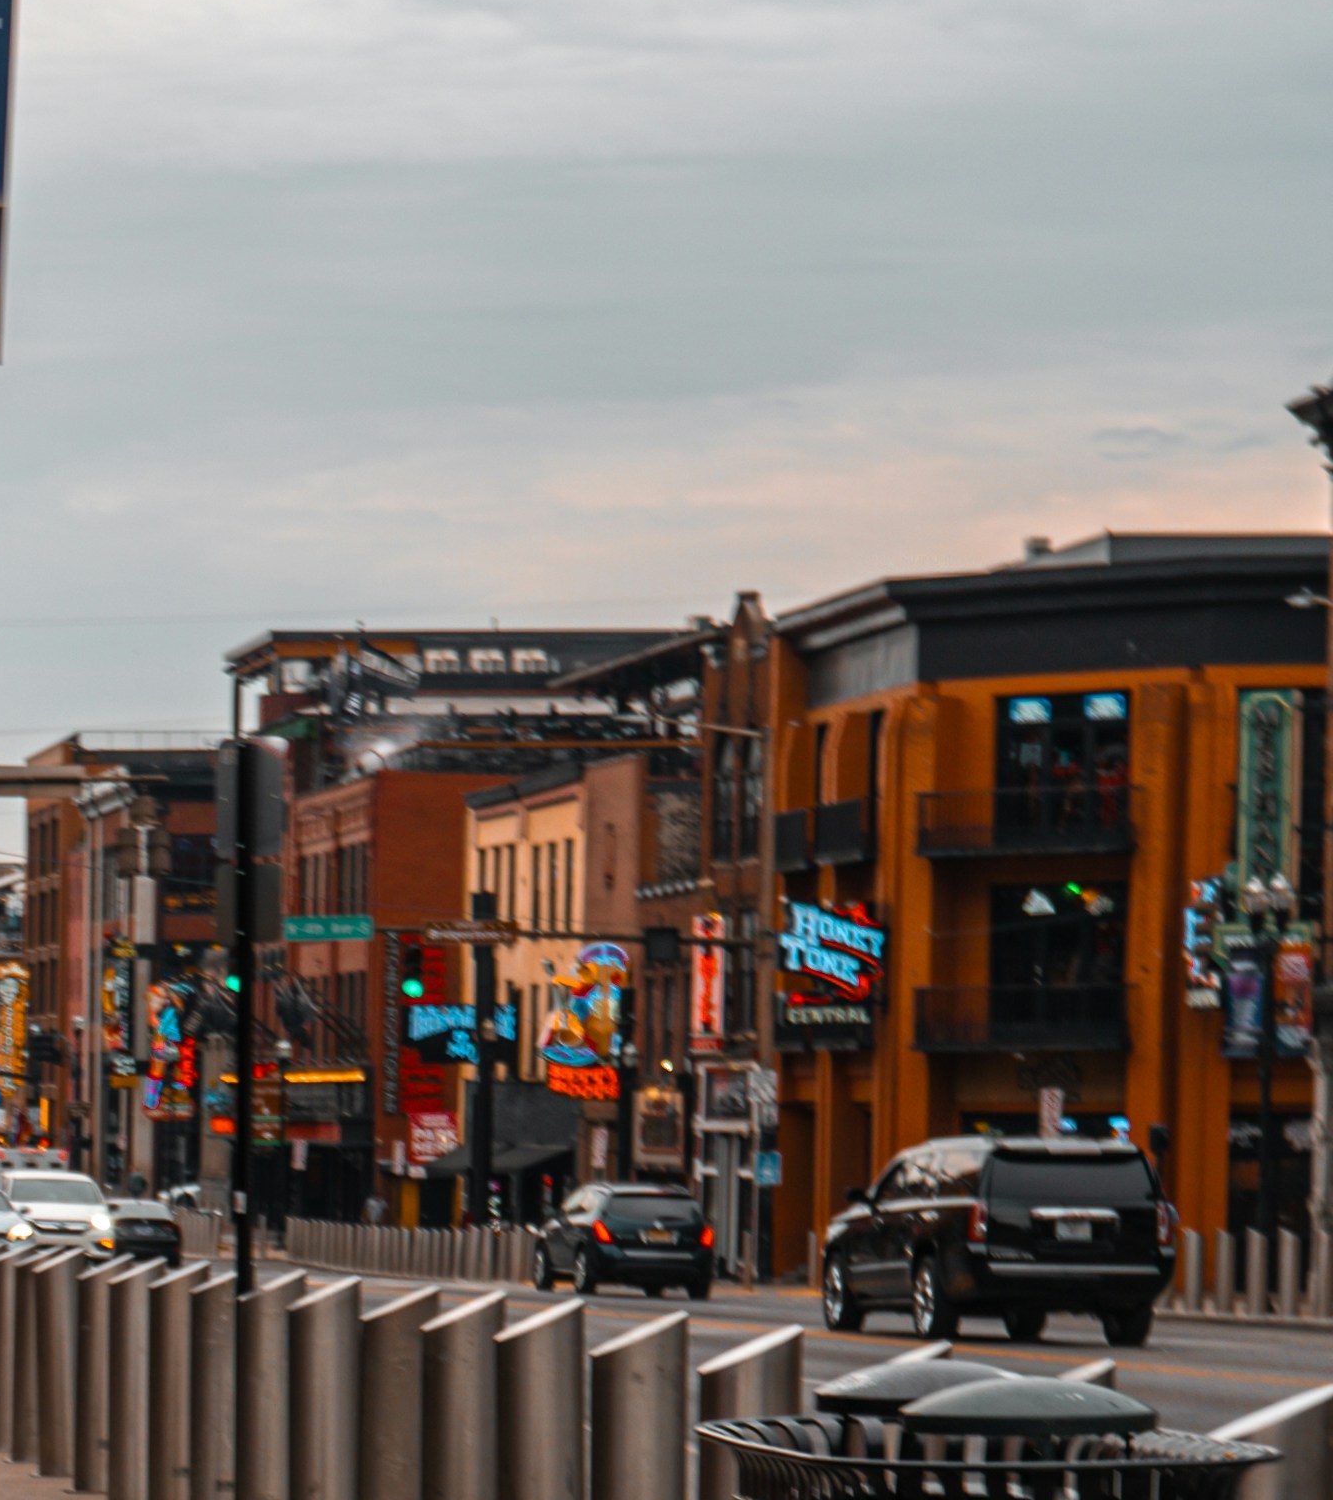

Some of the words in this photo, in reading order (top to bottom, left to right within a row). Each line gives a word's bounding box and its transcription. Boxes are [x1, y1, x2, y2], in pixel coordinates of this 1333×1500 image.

[791, 902, 885, 959] HONKY
[780, 932, 860, 987] TONK
[787, 1005, 872, 1025] CENTRAL
